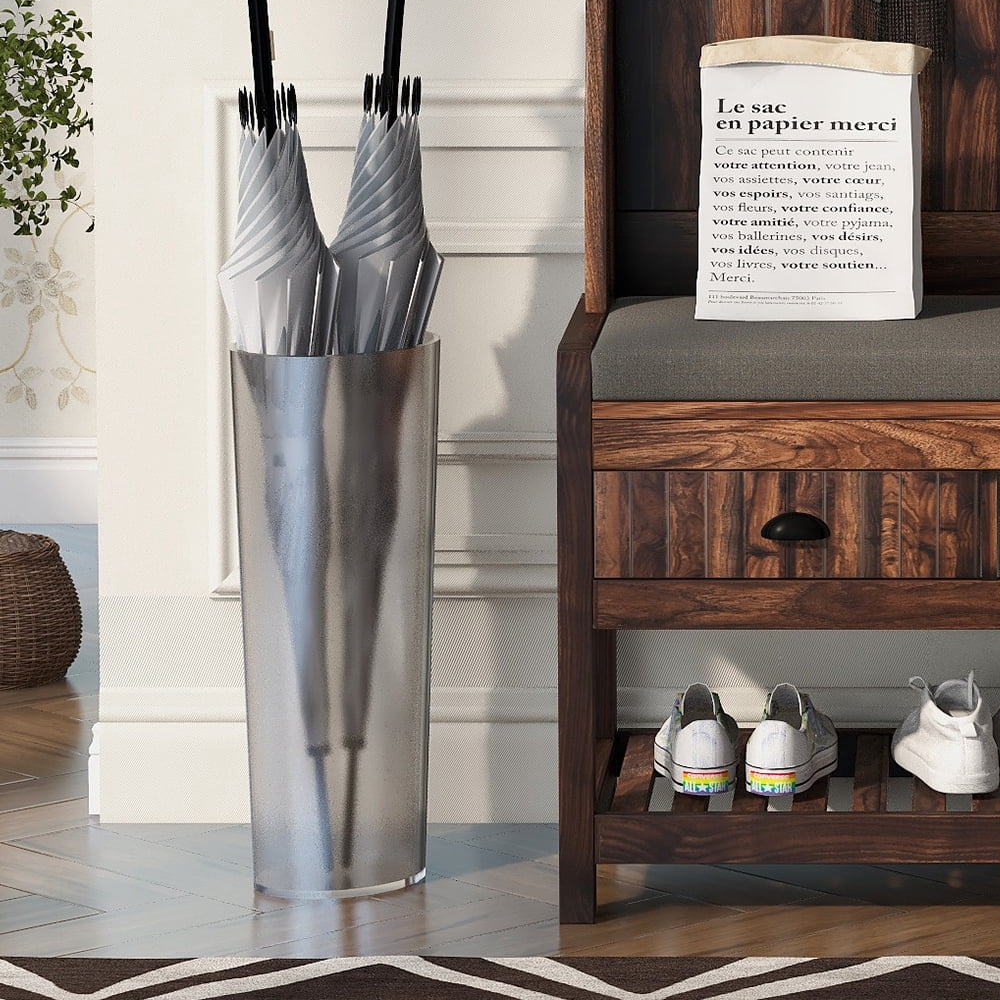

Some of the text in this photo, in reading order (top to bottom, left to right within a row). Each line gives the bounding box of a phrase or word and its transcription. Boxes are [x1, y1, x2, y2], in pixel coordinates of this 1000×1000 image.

[716, 97, 787, 114] Le sac
[715, 116, 897, 136] en papier merci
[714, 144, 855, 159] Ce sac peut contenir
[712, 161, 749, 170] votre
[750, 160, 821, 172] attention,
[825, 162, 861, 171] votre
[712, 176, 735, 185] vos
[738, 174, 798, 186] assiettes,
[801, 176, 841, 185] votre
[712, 190, 737, 198] vos
[738, 189, 793, 202] espoirs,
[797, 191, 822, 199] vos
[712, 201, 894, 216] vos fleurs, votre confiance,
[711, 216, 748, 227] votre
[801, 219, 838, 228] votre
[711, 233, 734, 241] vos
[737, 230, 807, 243] ballerines,
[711, 247, 736, 255] vos
[782, 248, 806, 256] vos
[809, 244, 864, 259] disques,
[709, 260, 733, 269] vos
[736, 258, 777, 271] livres,
[780, 261, 819, 270] votre
[709, 271, 755, 284] Merci.
